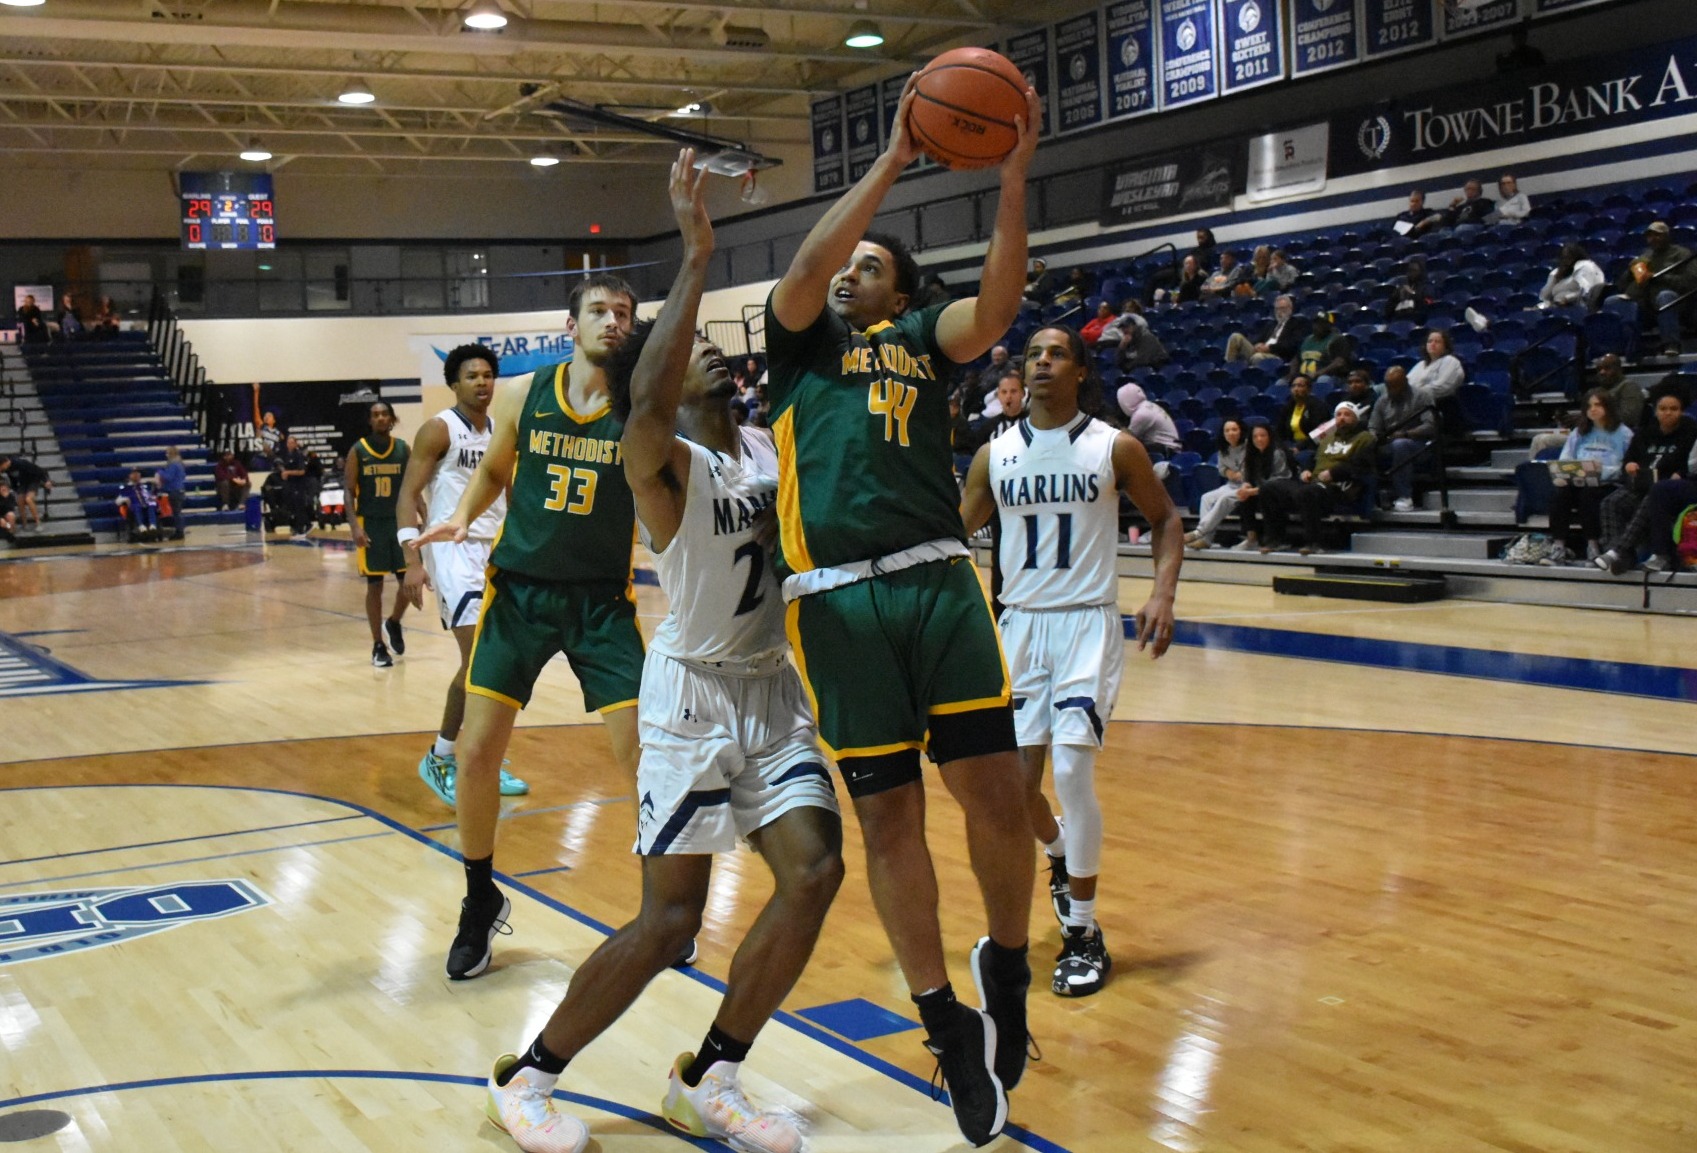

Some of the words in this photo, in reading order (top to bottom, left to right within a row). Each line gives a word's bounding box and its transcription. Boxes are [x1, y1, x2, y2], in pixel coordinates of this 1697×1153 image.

[1234, 31, 1268, 50] SWEET
[1379, 20, 1419, 45] 2012
[1307, 39, 1345, 63] 2012
[1235, 57, 1269, 80] 2011
[1170, 76, 1206, 98] 2009
[1649, 54, 1697, 107] A
[1116, 90, 1147, 111] 2007
[188, 200, 211, 218] 29
[223, 200, 233, 212] 2
[250, 200, 273, 218] 29
[189, 224, 201, 242] 0
[262, 224, 274, 242] 0
[535, 333, 572, 354] THE
[841, 343, 937, 381] MEODT
[867, 377, 918, 448] 44
[529, 429, 623, 466] METHODIST
[374, 476, 392, 498] 10
[543, 463, 599, 516] 33
[1000, 473, 1099, 507] MARLINS
[1021, 513, 1073, 570] 11
[732, 541, 767, 618] 2
